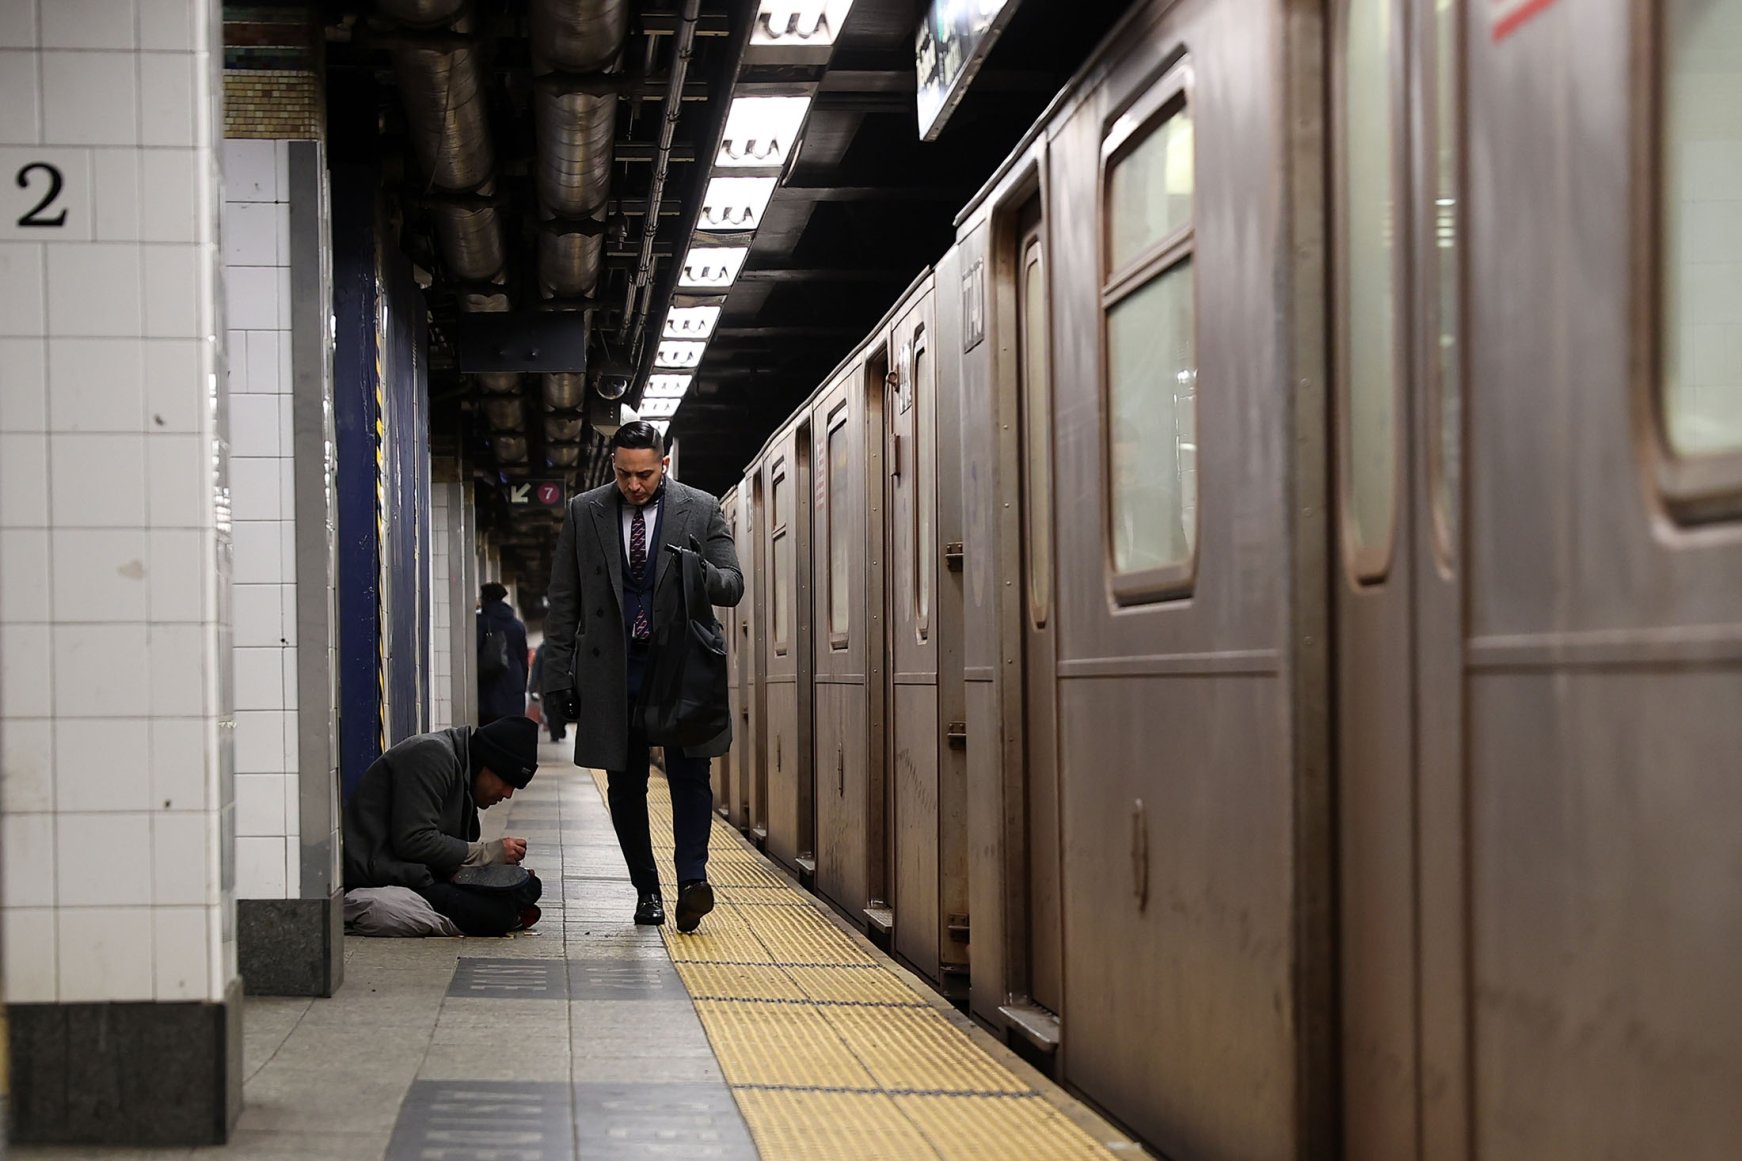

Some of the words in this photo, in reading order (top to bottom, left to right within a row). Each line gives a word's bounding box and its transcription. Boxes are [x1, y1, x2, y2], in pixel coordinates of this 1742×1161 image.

[17, 162, 67, 226] 2
[544, 487, 553, 500] 7
[470, 963, 547, 990] ASIDE
